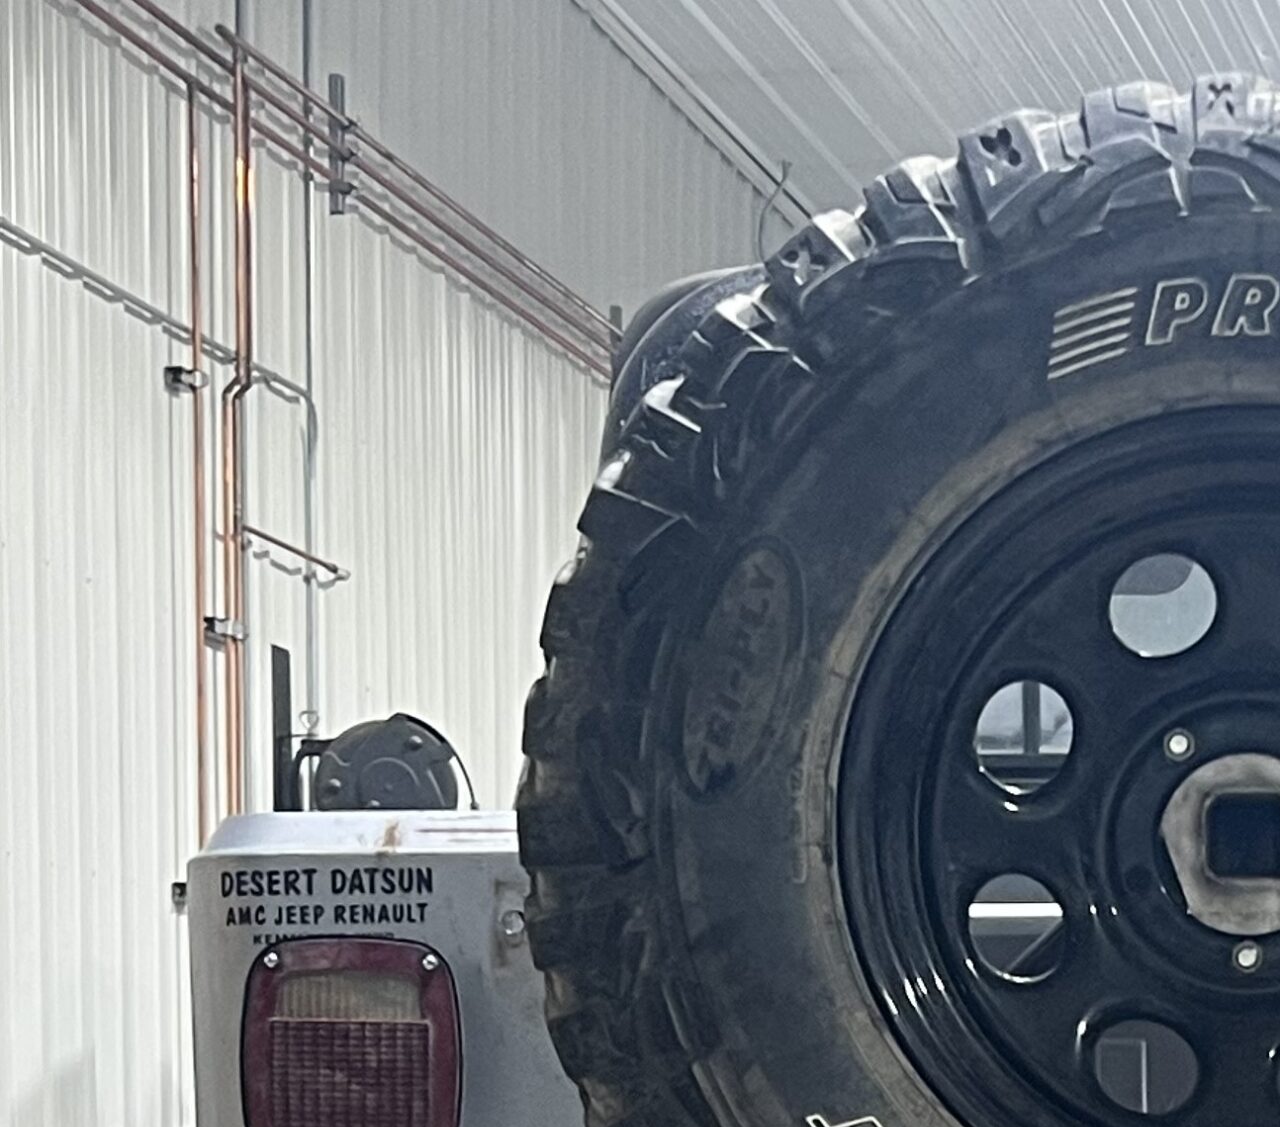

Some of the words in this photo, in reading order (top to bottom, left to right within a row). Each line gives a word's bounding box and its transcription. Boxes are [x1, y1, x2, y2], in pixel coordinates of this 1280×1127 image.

[221, 868, 318, 898] DESERT
[330, 867, 434, 896] DATSUN
[226, 905, 267, 927] AMC
[274, 904, 325, 926] JEEP
[334, 902, 429, 924] RENAULT
